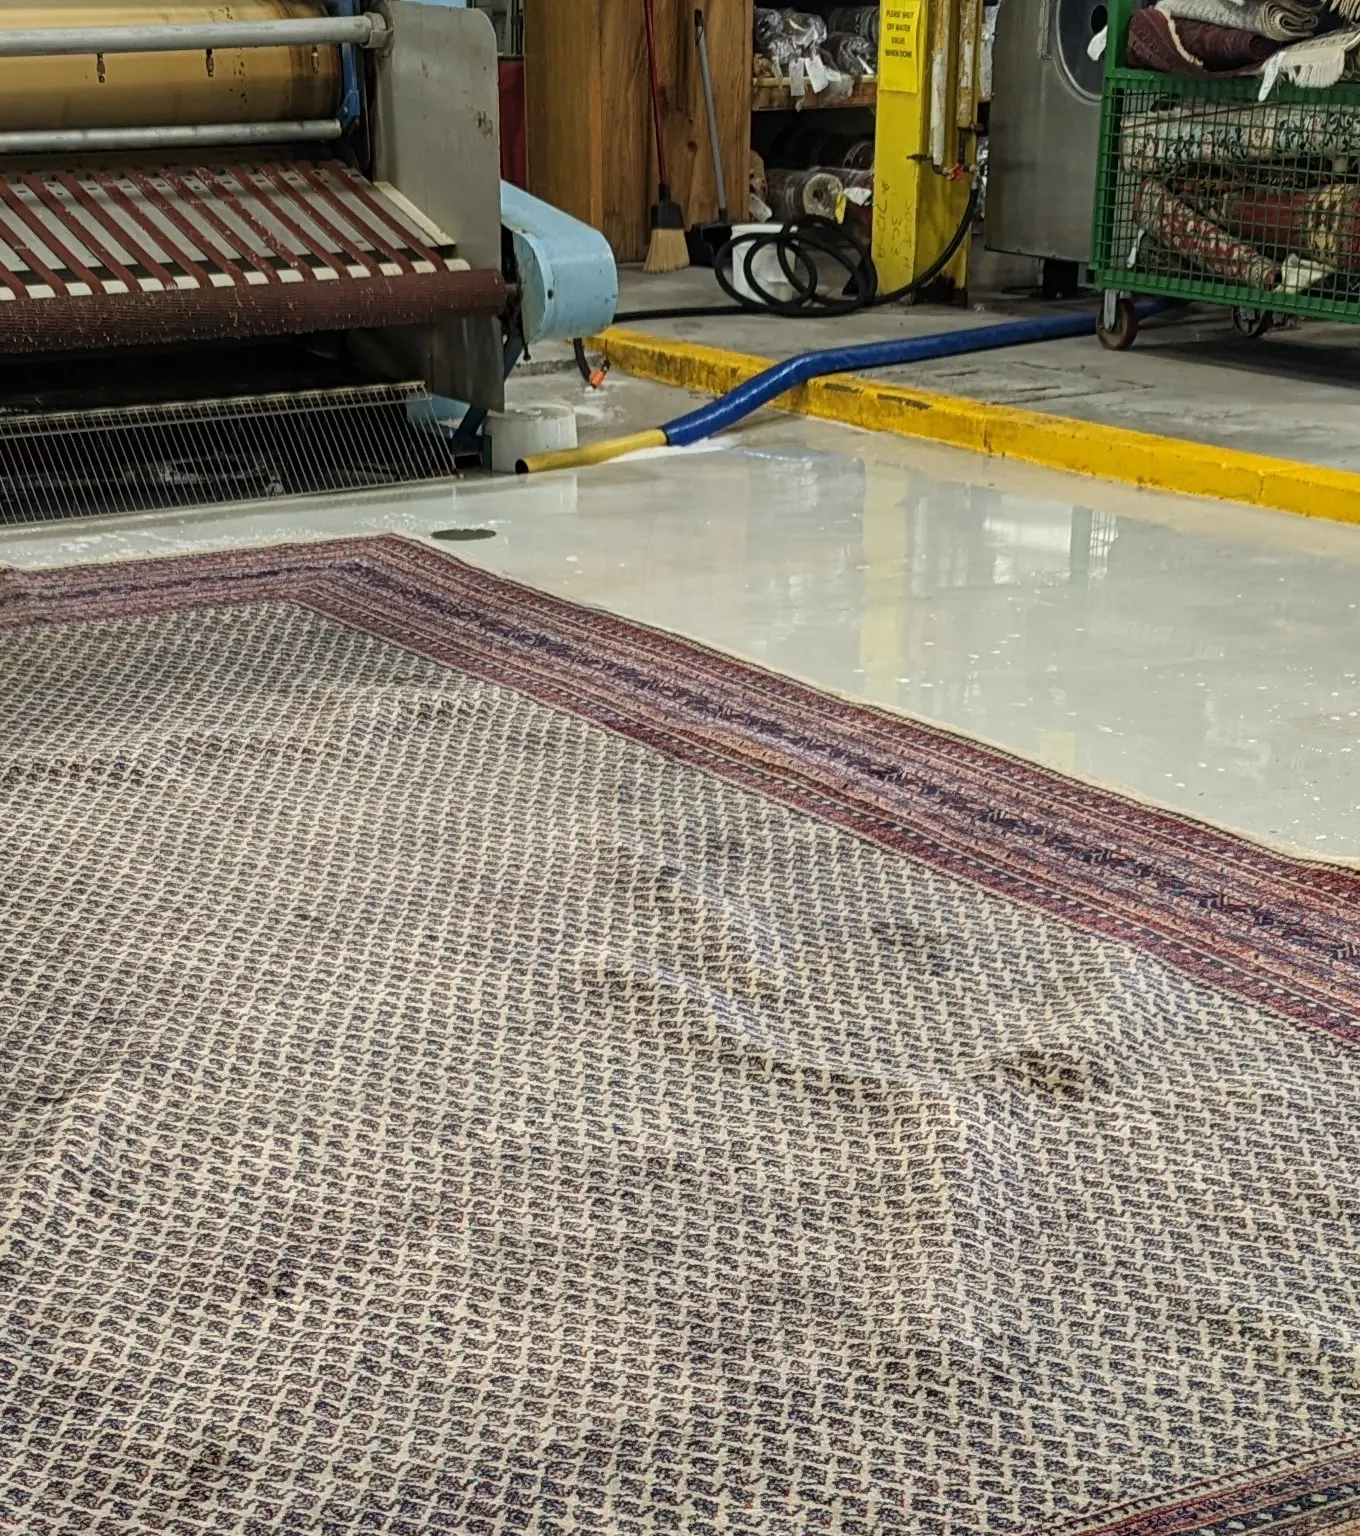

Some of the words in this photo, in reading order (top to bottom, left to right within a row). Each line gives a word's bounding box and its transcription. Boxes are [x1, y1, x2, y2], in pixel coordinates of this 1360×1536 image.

[886, 10, 901, 18] PLEASE
[902, 11, 914, 19] SHUT
[895, 24, 911, 32] WATER
[885, 49, 899, 57] WHEN
[900, 50, 912, 58] DONE
